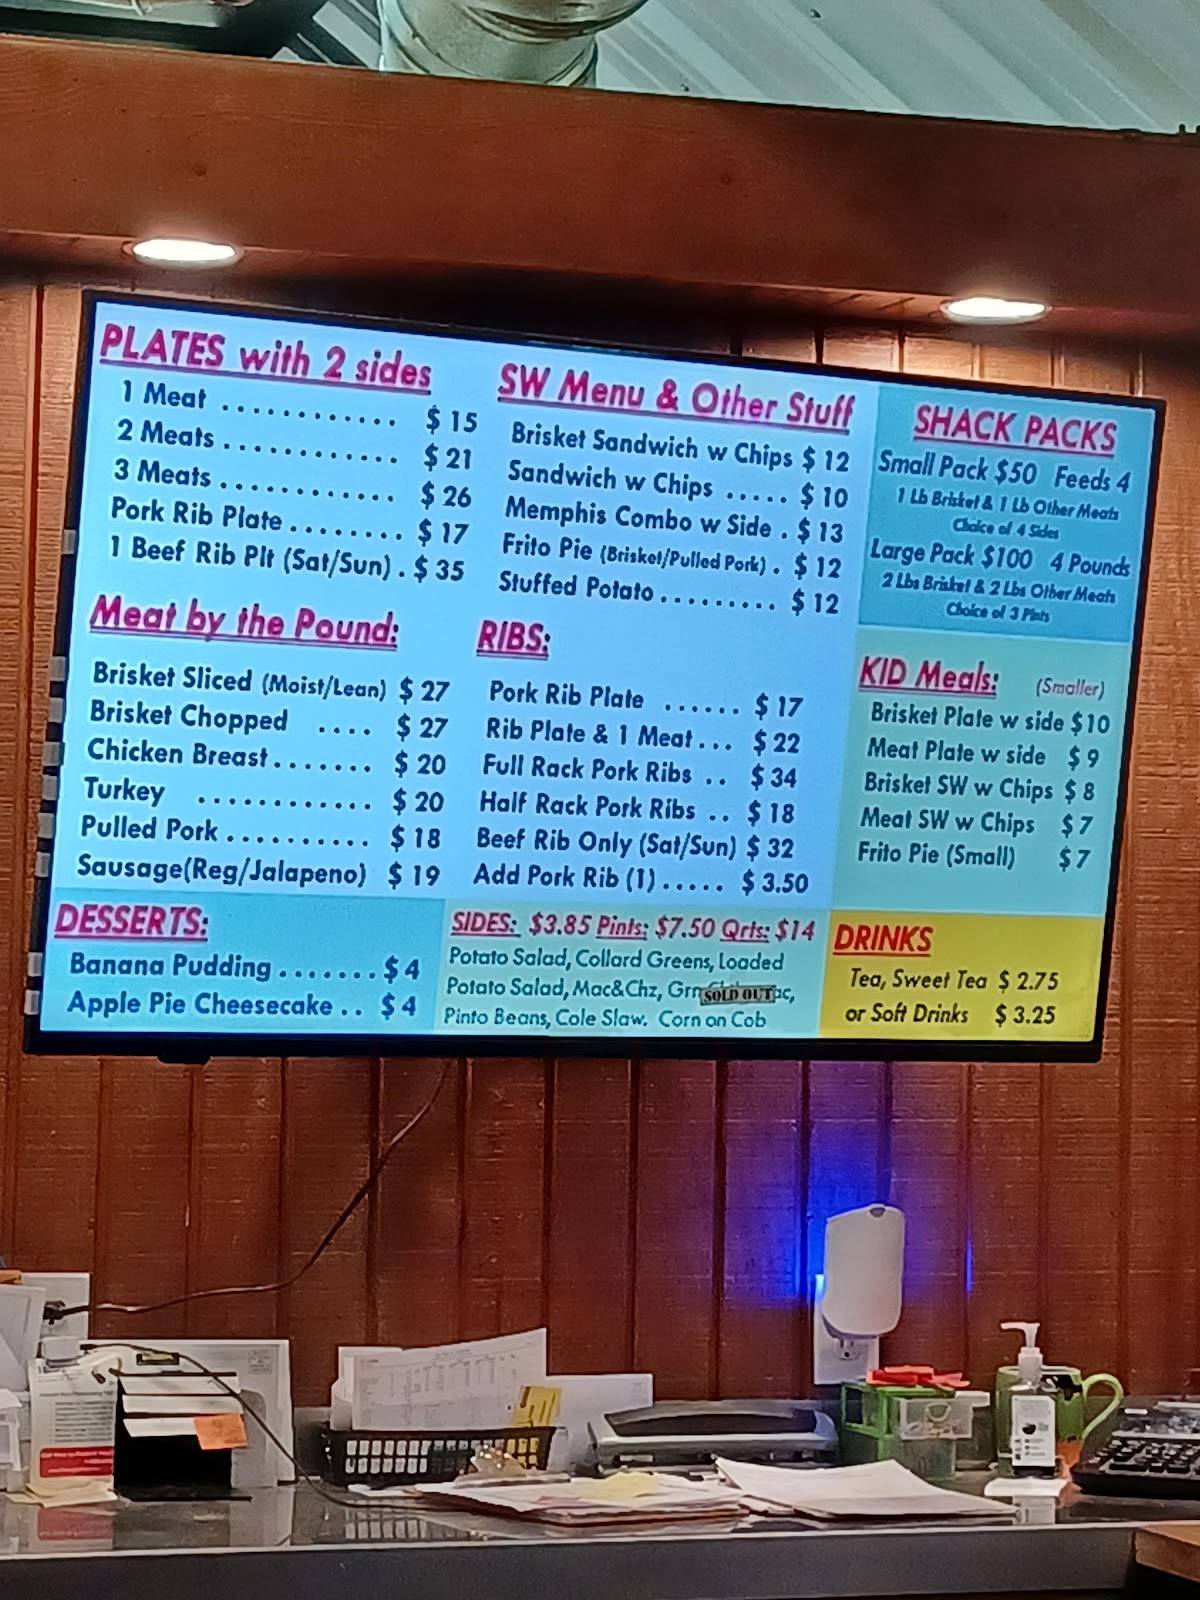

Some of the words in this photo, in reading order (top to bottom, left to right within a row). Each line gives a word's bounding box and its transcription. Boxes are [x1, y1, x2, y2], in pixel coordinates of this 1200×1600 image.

[101, 322, 226, 367] PLATES
[240, 340, 310, 378] with
[323, 345, 346, 379] 2
[355, 350, 432, 387] sides
[124, 380, 132, 402] 1
[144, 381, 206, 409] Meat
[499, 362, 551, 398] SW
[558, 369, 645, 409] Menu
[656, 379, 679, 412] &
[692, 383, 778, 420] Other
[786, 390, 856, 427] Stuff
[118, 418, 133, 441] 2
[140, 420, 214, 448] Meats
[914, 404, 1017, 442] SHACK
[1024, 416, 1117, 452] PACKS
[512, 421, 586, 449] Brisket
[593, 429, 698, 459] Sandwich
[707, 445, 728, 461] w
[734, 442, 793, 471] Chips
[114, 458, 129, 480] 3
[137, 459, 211, 487] Meats
[878, 449, 936, 476] Small
[939, 455, 988, 481] Pack
[994, 459, 1037, 485] $50
[1054, 466, 1111, 492] Feeds
[1116, 472, 1131, 493] 4
[112, 496, 164, 522] Pork
[173, 501, 213, 526] Rib
[223, 505, 282, 530] Plate
[505, 495, 606, 527] Memphis
[615, 505, 692, 531] Combo
[700, 518, 721, 533] w
[727, 514, 771, 537] Side
[898, 487, 905, 503] 1
[910, 488, 928, 504] Lb
[931, 491, 980, 509] Brisket
[982, 495, 993, 510] &
[1000, 496, 1007, 512] 1
[1012, 497, 1030, 513] Lb
[1034, 499, 1075, 517] Other
[1076, 503, 1119, 520] Meats
[953, 518, 994, 534] Choice
[998, 521, 1013, 535] of
[1017, 524, 1026, 537] 4
[1028, 524, 1059, 539] Sides
[111, 535, 119, 557] 1
[132, 536, 186, 561] Beef
[196, 541, 235, 565] Rib
[244, 545, 275, 568] Plt
[284, 547, 390, 581] (Sat/Sun)
[503, 532, 551, 556] Frito
[559, 537, 592, 560] Pie
[725, 555, 766, 576] Pork)
[870, 538, 925, 566] Large
[930, 542, 975, 566] Pack
[981, 545, 1033, 570] $100
[1050, 552, 1064, 572] 4
[1068, 553, 1130, 577] Pounds
[499, 570, 577, 596] Stuffed
[587, 576, 653, 601] Potato
[882, 572, 893, 588] 2
[896, 572, 919, 590] Lbs
[923, 575, 971, 593] Brisket
[974, 579, 985, 594] &
[989, 581, 1000, 595] 2
[1003, 580, 1026, 597] Lbs
[1031, 583, 1072, 600] Other
[1073, 586, 1115, 604] Meats
[89, 594, 177, 630] Meat
[185, 598, 227, 642] by
[236, 603, 285, 635] the
[294, 607, 399, 643] Pound:
[946, 602, 988, 618] Choice
[992, 605, 1006, 619] of
[1009, 606, 1019, 620] 3
[477, 619, 551, 652] RIBS:
[94, 661, 175, 687] Brisket
[183, 666, 252, 691] Sliced
[262, 673, 386, 702] (Moist/Lean)
[859, 655, 907, 685] KID
[915, 660, 999, 691] Meals:
[1036, 677, 1104, 701] (Smaller)
[90, 699, 172, 725] Brisket
[181, 704, 288, 735] Chopped
[871, 701, 938, 725] Brisket
[944, 706, 993, 728] Plate
[1000, 715, 1019, 728] w
[1025, 710, 1064, 731] side
[1071, 711, 1110, 736] $10
[88, 738, 183, 764] Chicken
[193, 743, 268, 767] Breast
[483, 753, 524, 776] Full
[532, 756, 584, 779] Rack
[591, 758, 639, 781] Pork
[646, 761, 692, 784] Ribs
[84, 776, 165, 807] Turkey
[864, 771, 931, 794] Brisket
[937, 774, 968, 795] SW
[974, 783, 993, 796] w
[1000, 778, 1053, 804] Chips
[82, 815, 157, 839] Pulled
[166, 818, 218, 842] Pork
[477, 827, 525, 849] Beef
[534, 829, 570, 850] Rib
[578, 831, 633, 859] Only
[640, 832, 736, 861] (Sat/Sun)
[858, 841, 901, 862] Frito
[909, 843, 939, 863] Pie
[947, 844, 1015, 870] (Small)
[55, 903, 209, 936] DESSERTS:
[452, 911, 517, 934] SIDES:
[529, 911, 592, 936] $3.85
[596, 914, 649, 937] Pints:
[655, 916, 717, 939] $7.50
[720, 918, 770, 940] Qrts:
[775, 918, 815, 942] $14
[833, 924, 934, 953] DRINKS
[70, 952, 164, 976] Banana
[173, 953, 271, 982] Pudding
[449, 946, 508, 965] Potato
[513, 947, 571, 971] Salad,
[576, 948, 642, 967] Collard
[647, 951, 714, 973] Greens,
[719, 952, 784, 970] Loaded
[447, 976, 506, 995] Potato
[510, 977, 569, 1001] Salad,
[572, 979, 662, 1002] Mac&Chz,
[704, 988, 739, 1002] SOLD
[741, 987, 772, 1001] OUT
[851, 968, 886, 990] Tea,
[892, 968, 950, 989] Sweet
[958, 970, 987, 989] Tea
[67, 990, 141, 1018] Apple
[150, 992, 185, 1014] Pie
[195, 992, 333, 1015] Cheesecake
[444, 1007, 488, 1024] Pinto
[494, 1008, 551, 1030] Beans,
[556, 1008, 596, 1026] Cole
[659, 1010, 701, 1028] Corn
[705, 1016, 726, 1028] on
[731, 1010, 766, 1028] Cob
[845, 1009, 866, 1022] or
[871, 1002, 907, 1022] Soft
[913, 1003, 968, 1023] Drinks
